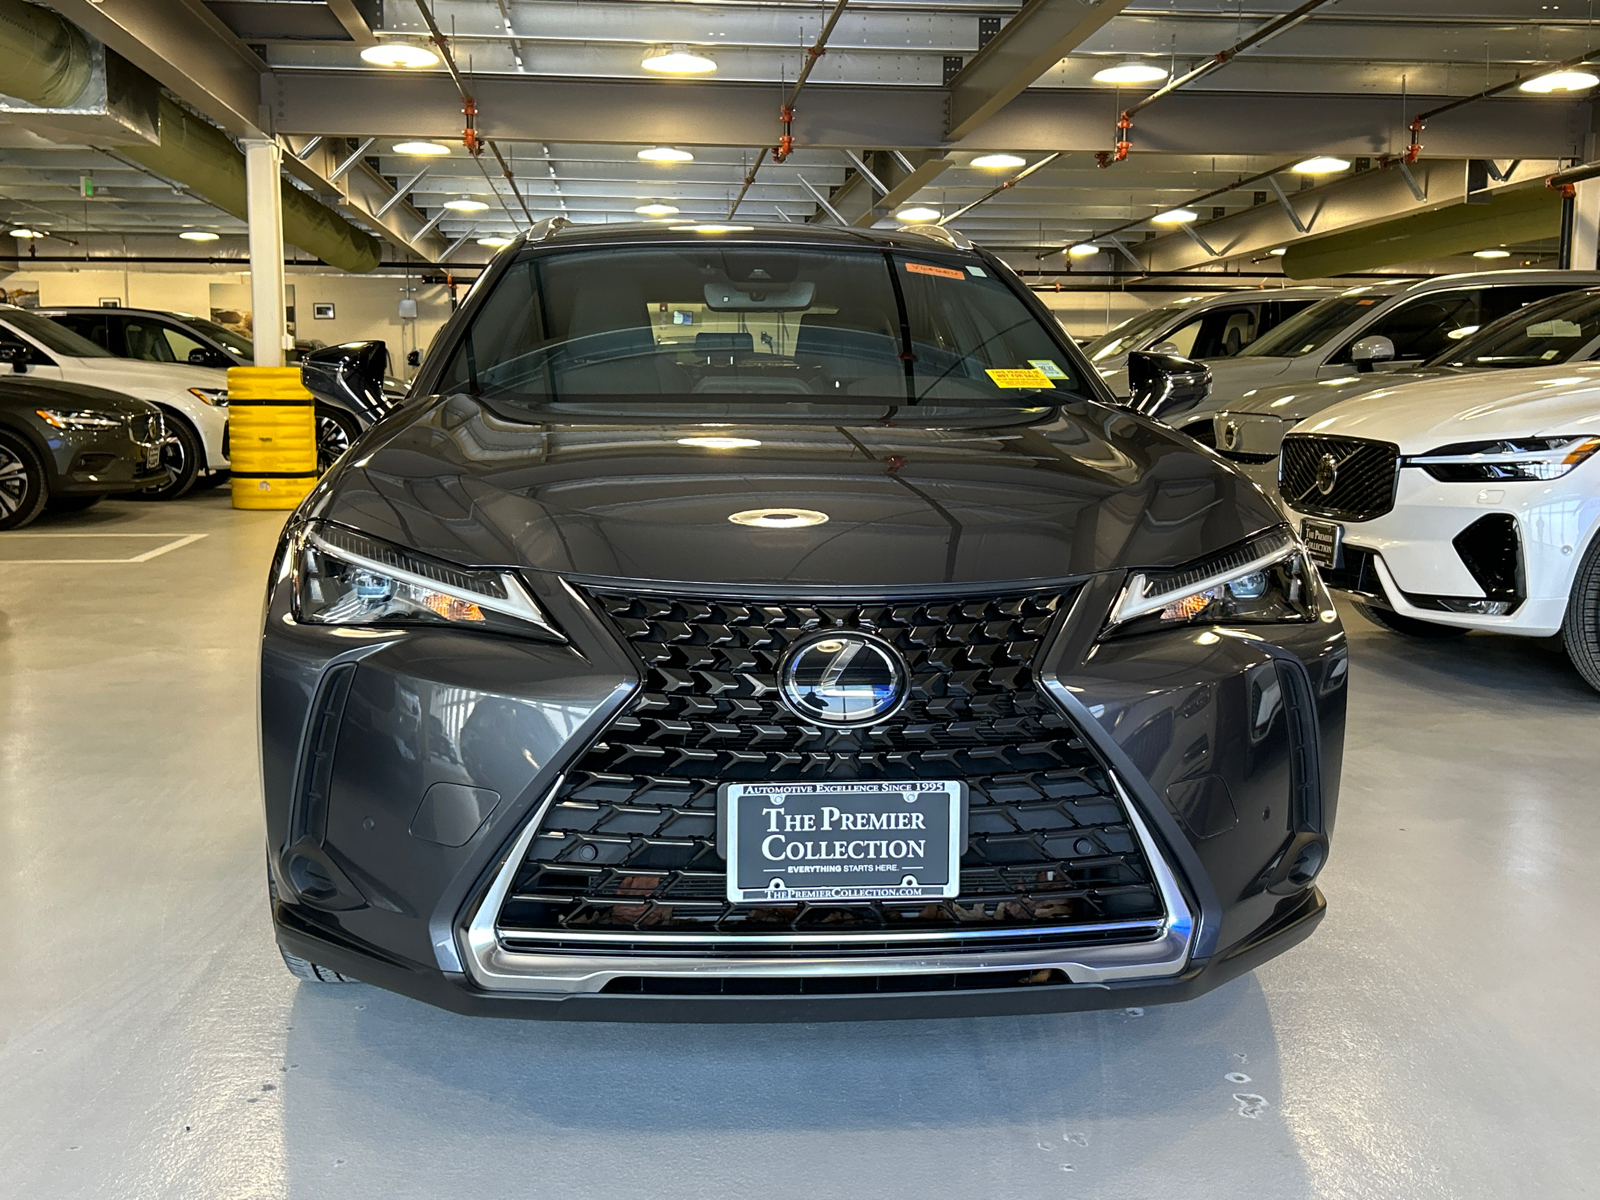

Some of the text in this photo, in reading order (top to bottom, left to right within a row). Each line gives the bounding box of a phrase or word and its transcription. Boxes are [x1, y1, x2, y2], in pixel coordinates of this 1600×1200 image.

[915, 782, 943, 791] 1995
[787, 864, 899, 873] EVERYTHING STARTS HERE.
